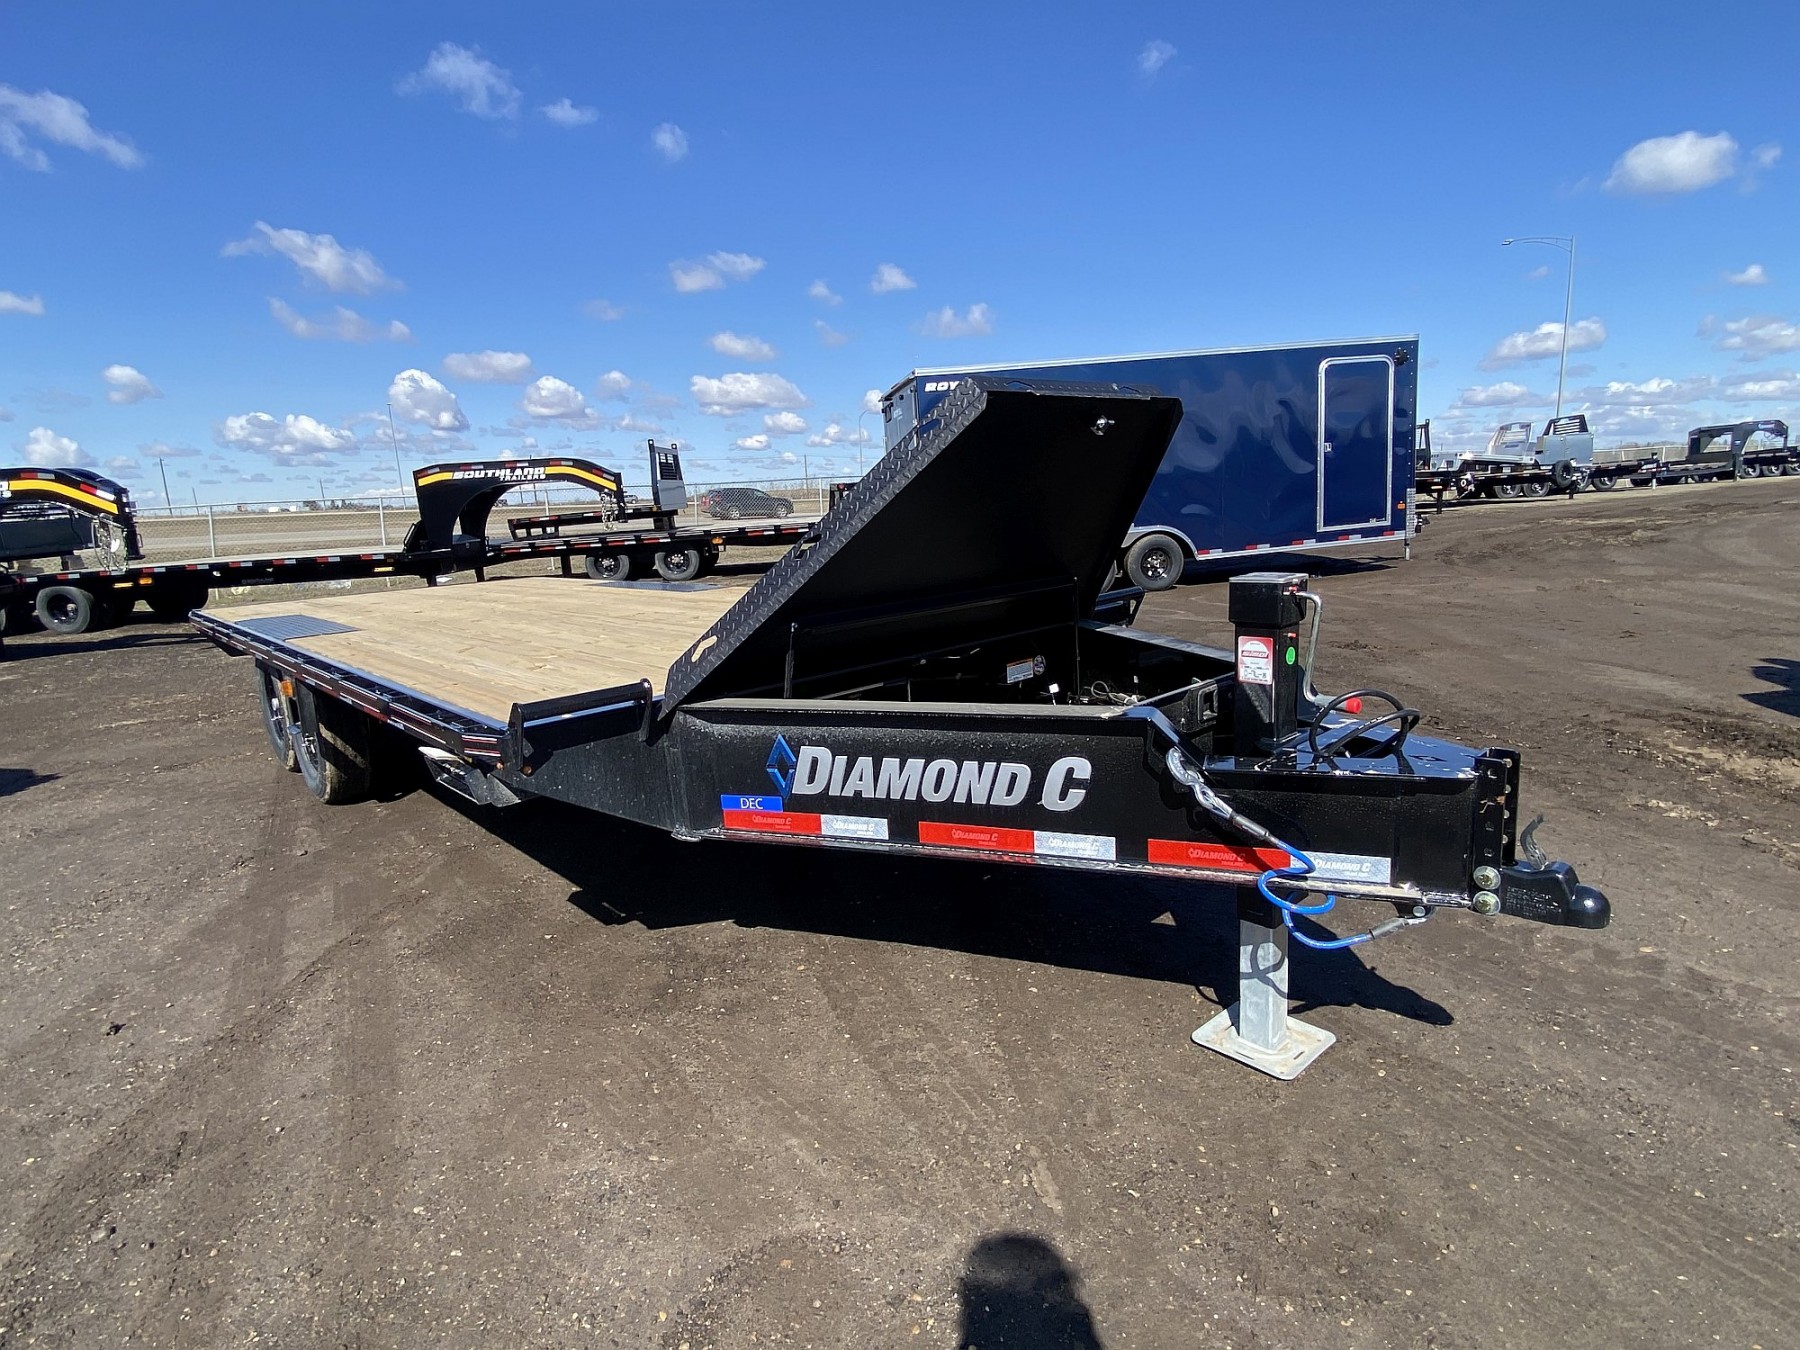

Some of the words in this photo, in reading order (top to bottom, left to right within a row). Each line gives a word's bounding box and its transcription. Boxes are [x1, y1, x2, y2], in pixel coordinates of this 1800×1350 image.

[452, 466, 545, 480] SOUTHLAND
[499, 474, 546, 482] TRAILERS
[792, 745, 1032, 807] DIAMOND
[1040, 756, 1093, 812] C
[740, 797, 764, 810] DEC
[786, 817, 792, 825] C
[992, 832, 999, 842] C
[1237, 853, 1246, 862] C
[1361, 862, 1371, 872] C
